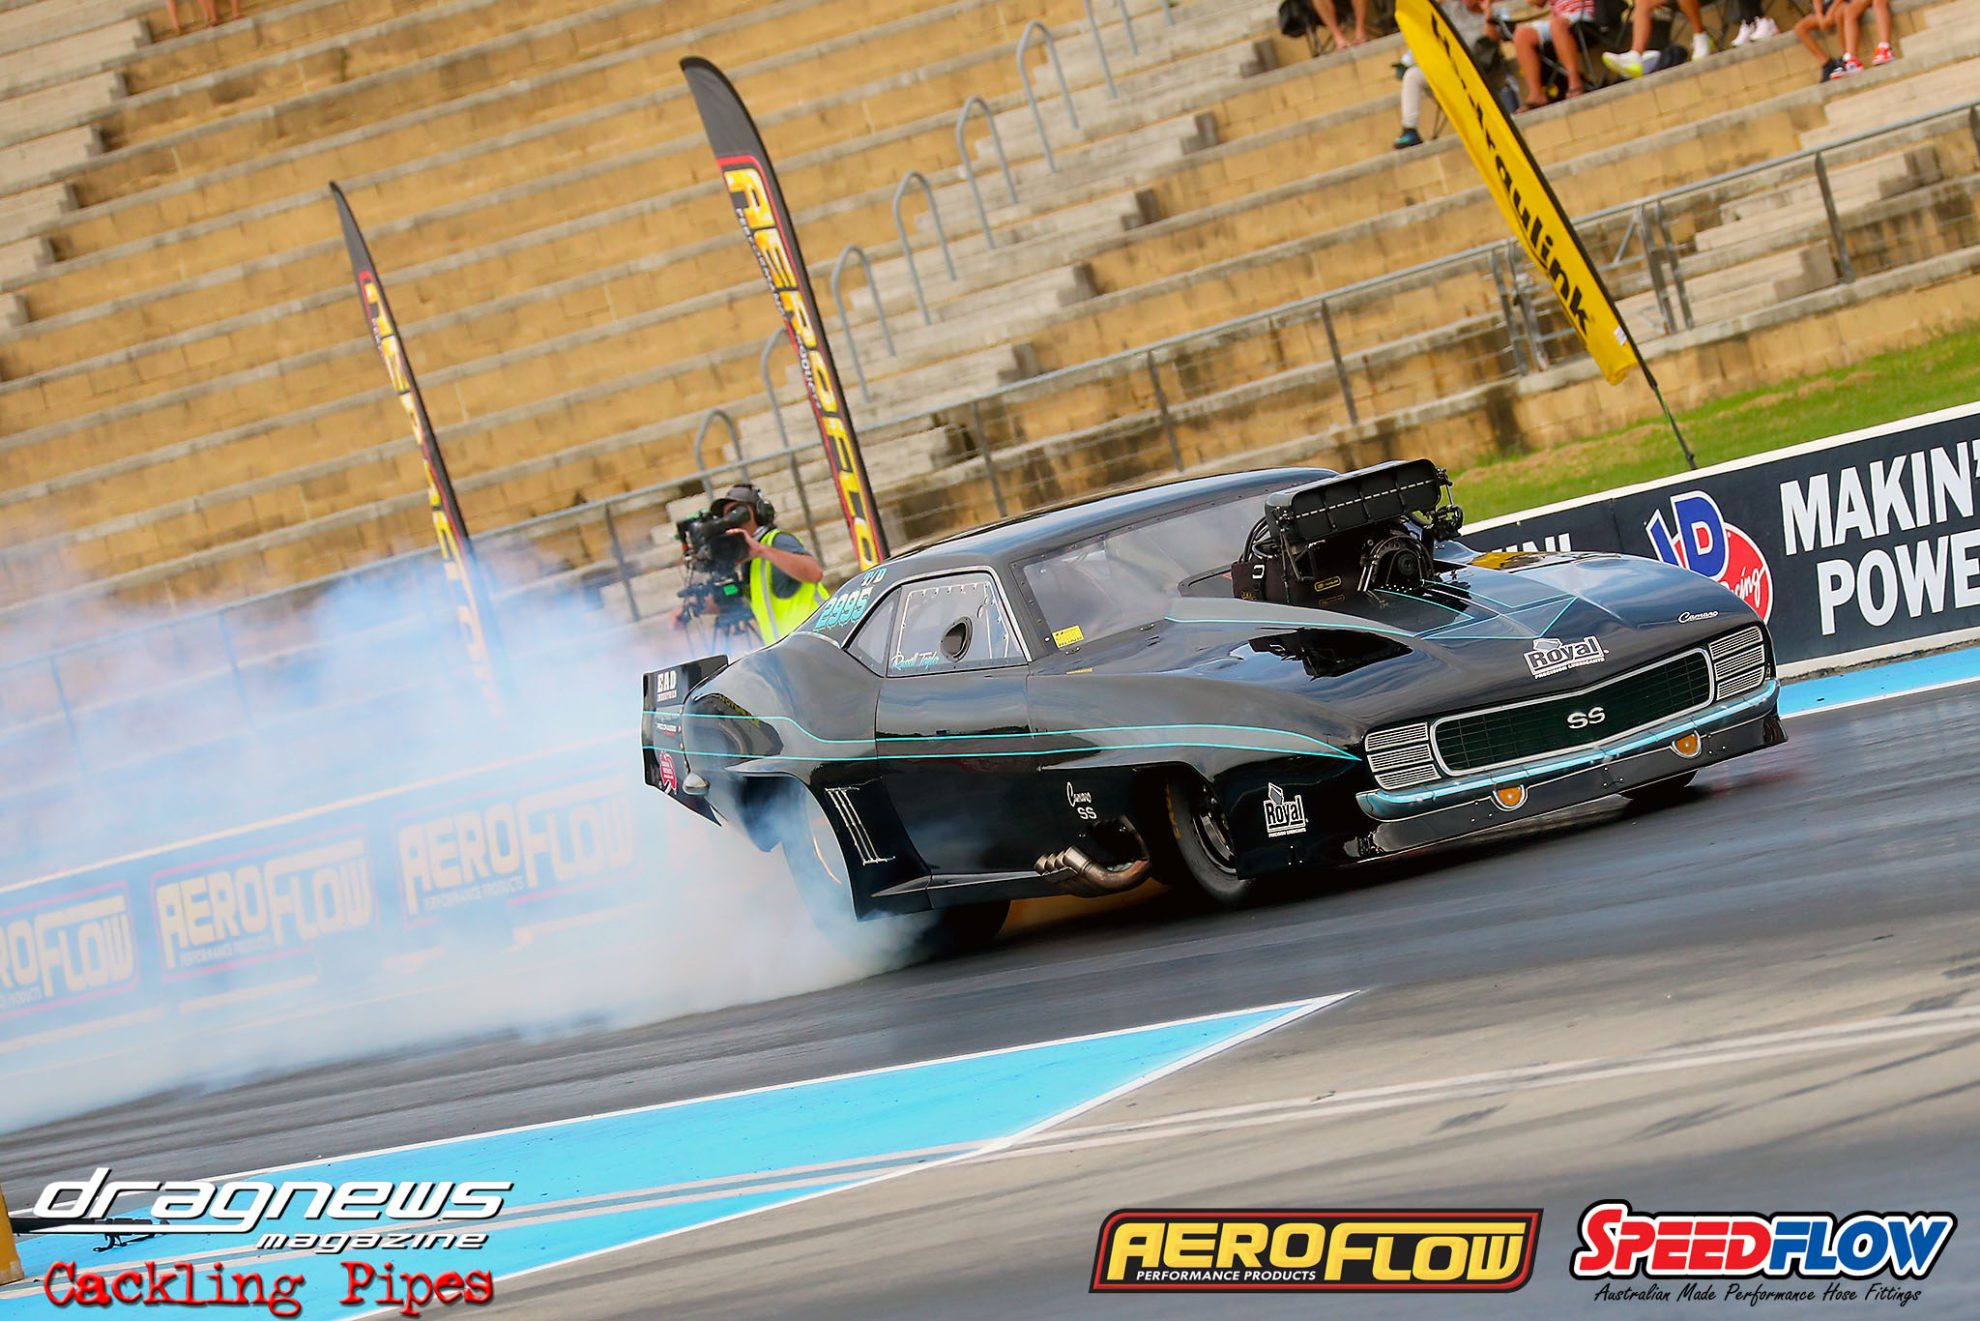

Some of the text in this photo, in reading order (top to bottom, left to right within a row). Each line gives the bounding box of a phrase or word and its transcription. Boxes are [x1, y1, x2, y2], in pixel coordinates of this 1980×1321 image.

[723, 168, 880, 573] AEROFLO
[813, 586, 874, 631] 2995
[1676, 609, 1720, 625] Camaro
[1528, 637, 1601, 669] Royal
[1566, 706, 1606, 729] SS
[1077, 806, 1098, 820] SS
[1264, 796, 1304, 828] Royal
[398, 773, 635, 915] AEROFLOW
[156, 839, 373, 970] AEROFLOW
